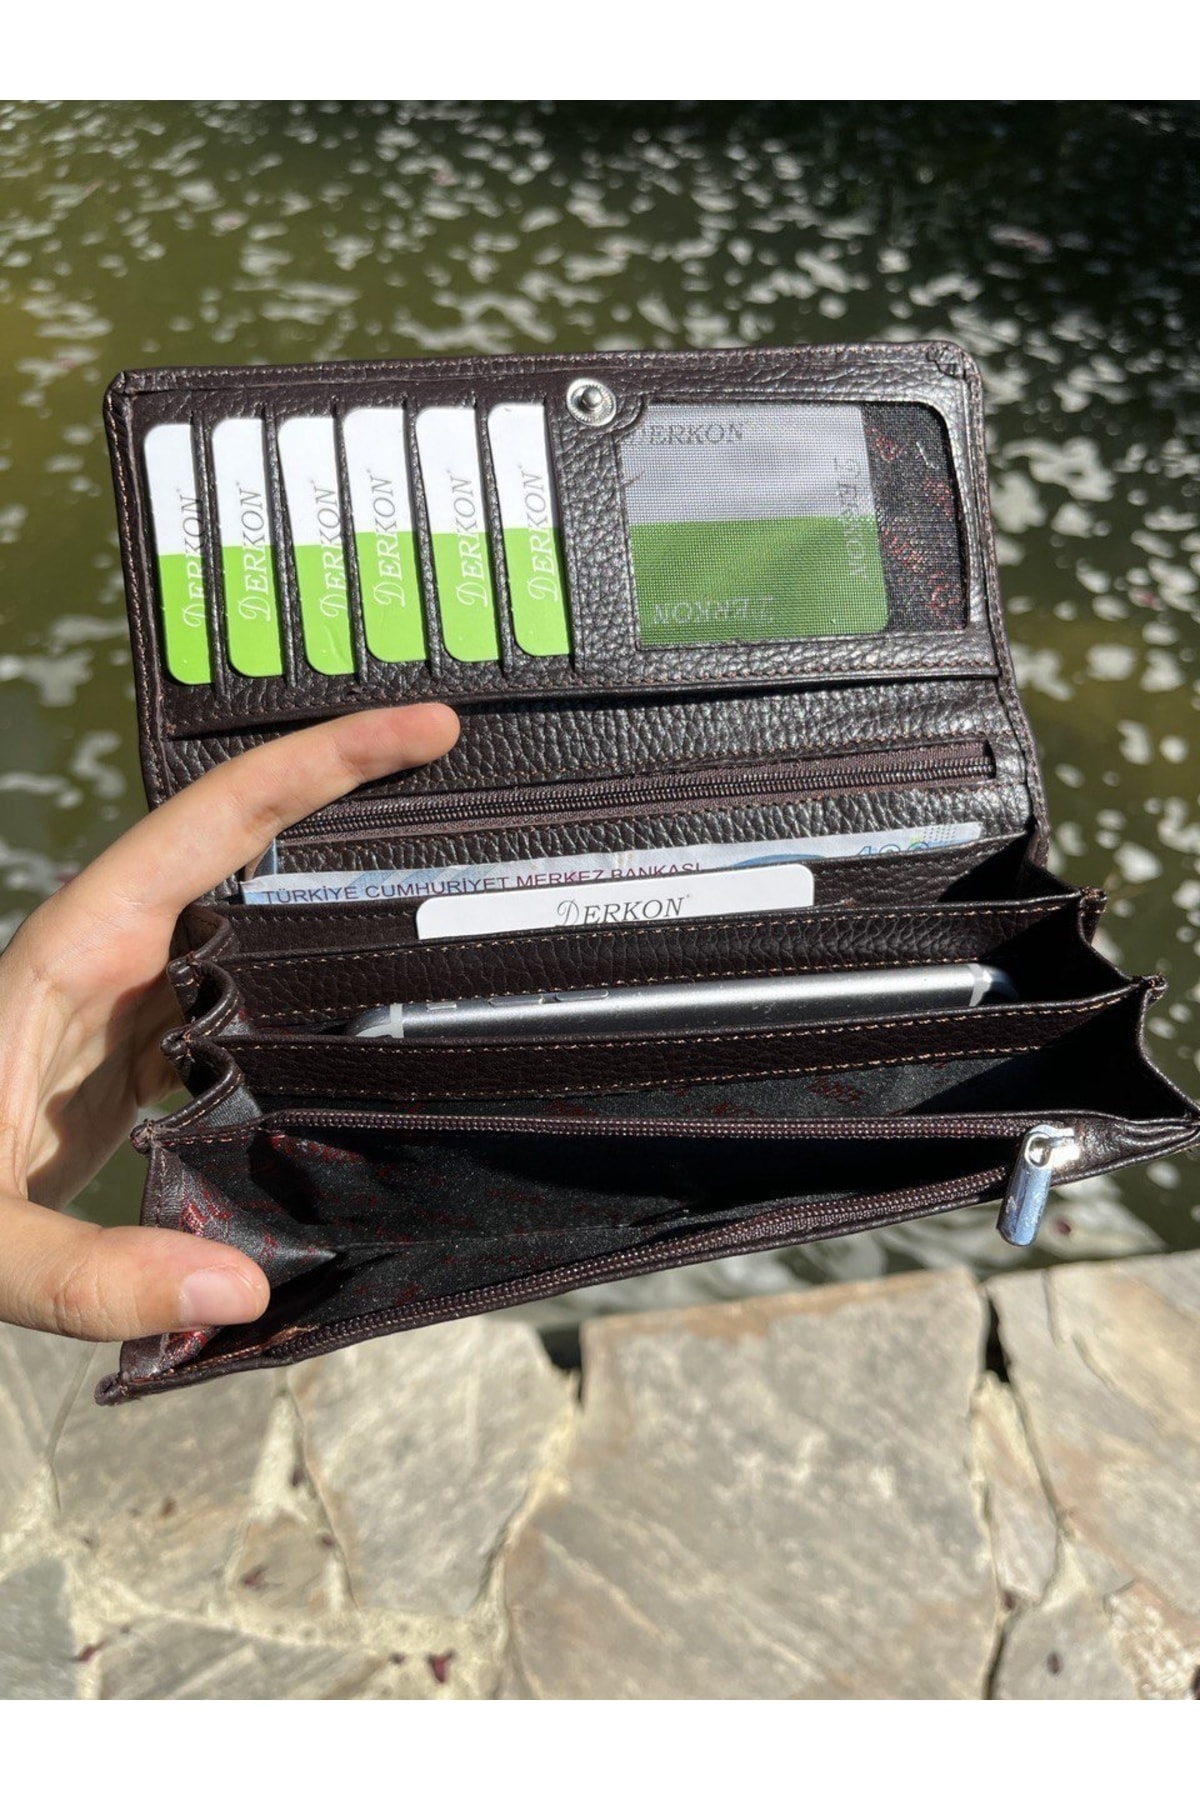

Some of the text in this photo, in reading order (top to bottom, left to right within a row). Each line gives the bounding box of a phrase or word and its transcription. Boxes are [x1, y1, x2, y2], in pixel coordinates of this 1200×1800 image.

[236, 488, 271, 622] DERKON
[313, 486, 348, 618] DERKON
[369, 475, 405, 607] DERKON
[449, 475, 488, 607] DERKON
[520, 470, 558, 602] DERKON
[263, 884, 360, 905] TÜRKİYE
[364, 876, 510, 899] CUMHURİYET
[555, 896, 686, 927] DERKON
